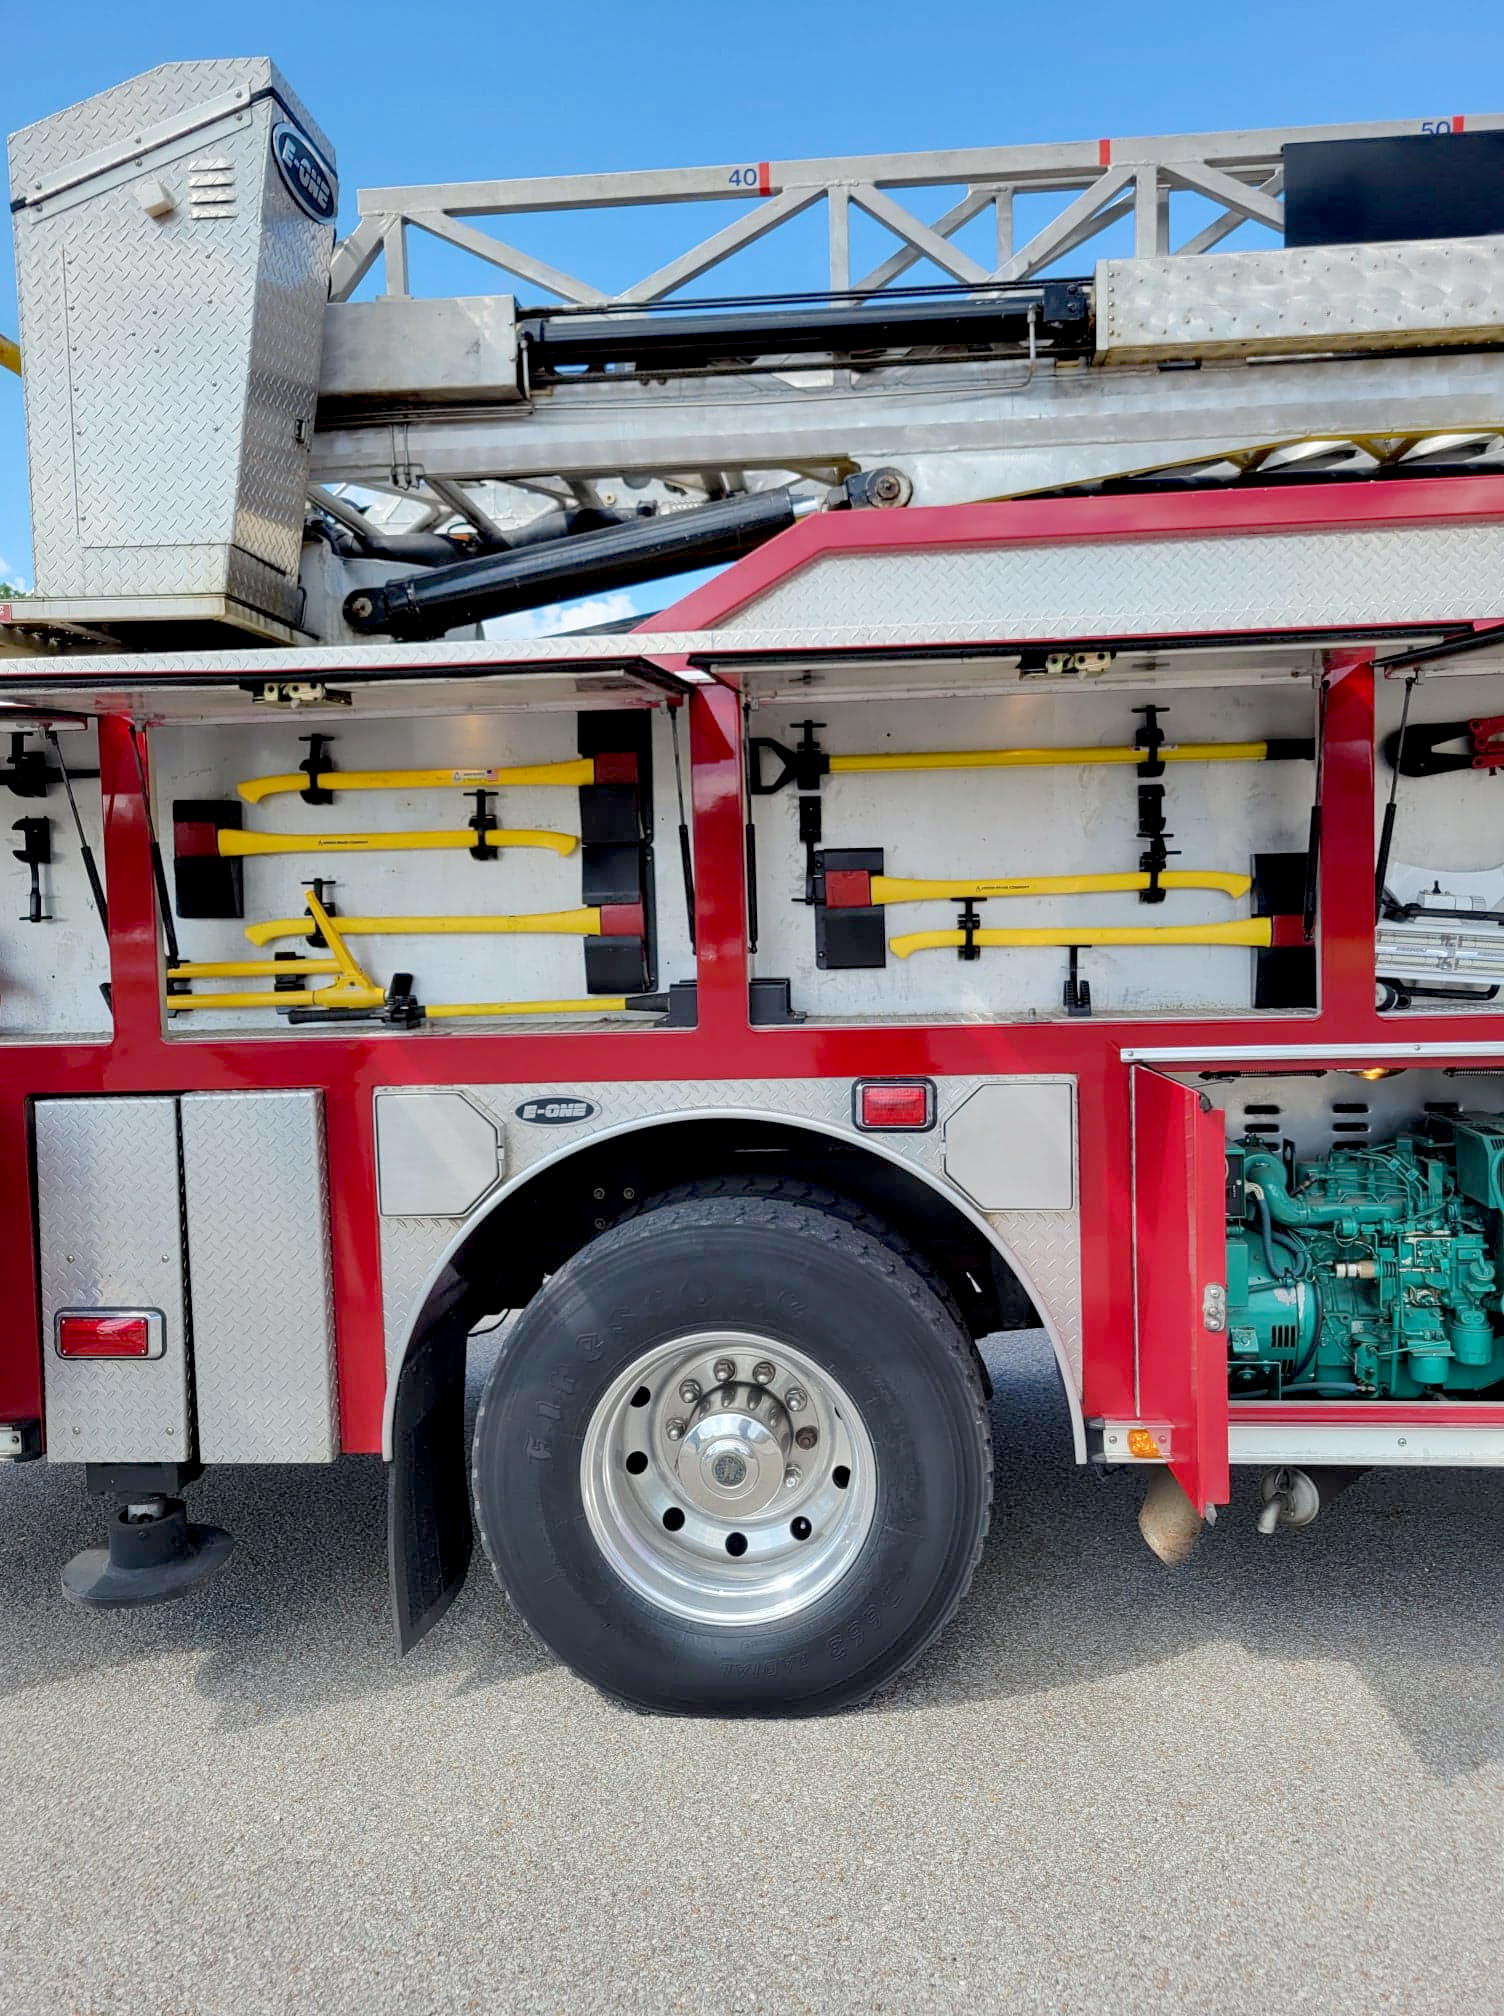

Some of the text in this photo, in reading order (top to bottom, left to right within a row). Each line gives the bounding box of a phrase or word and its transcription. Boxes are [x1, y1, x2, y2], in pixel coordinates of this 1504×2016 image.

[1421, 121, 1451, 135] 50
[282, 136, 330, 209] E-ONE
[728, 168, 757, 187] 40
[522, 1103, 587, 1119] E-ONE
